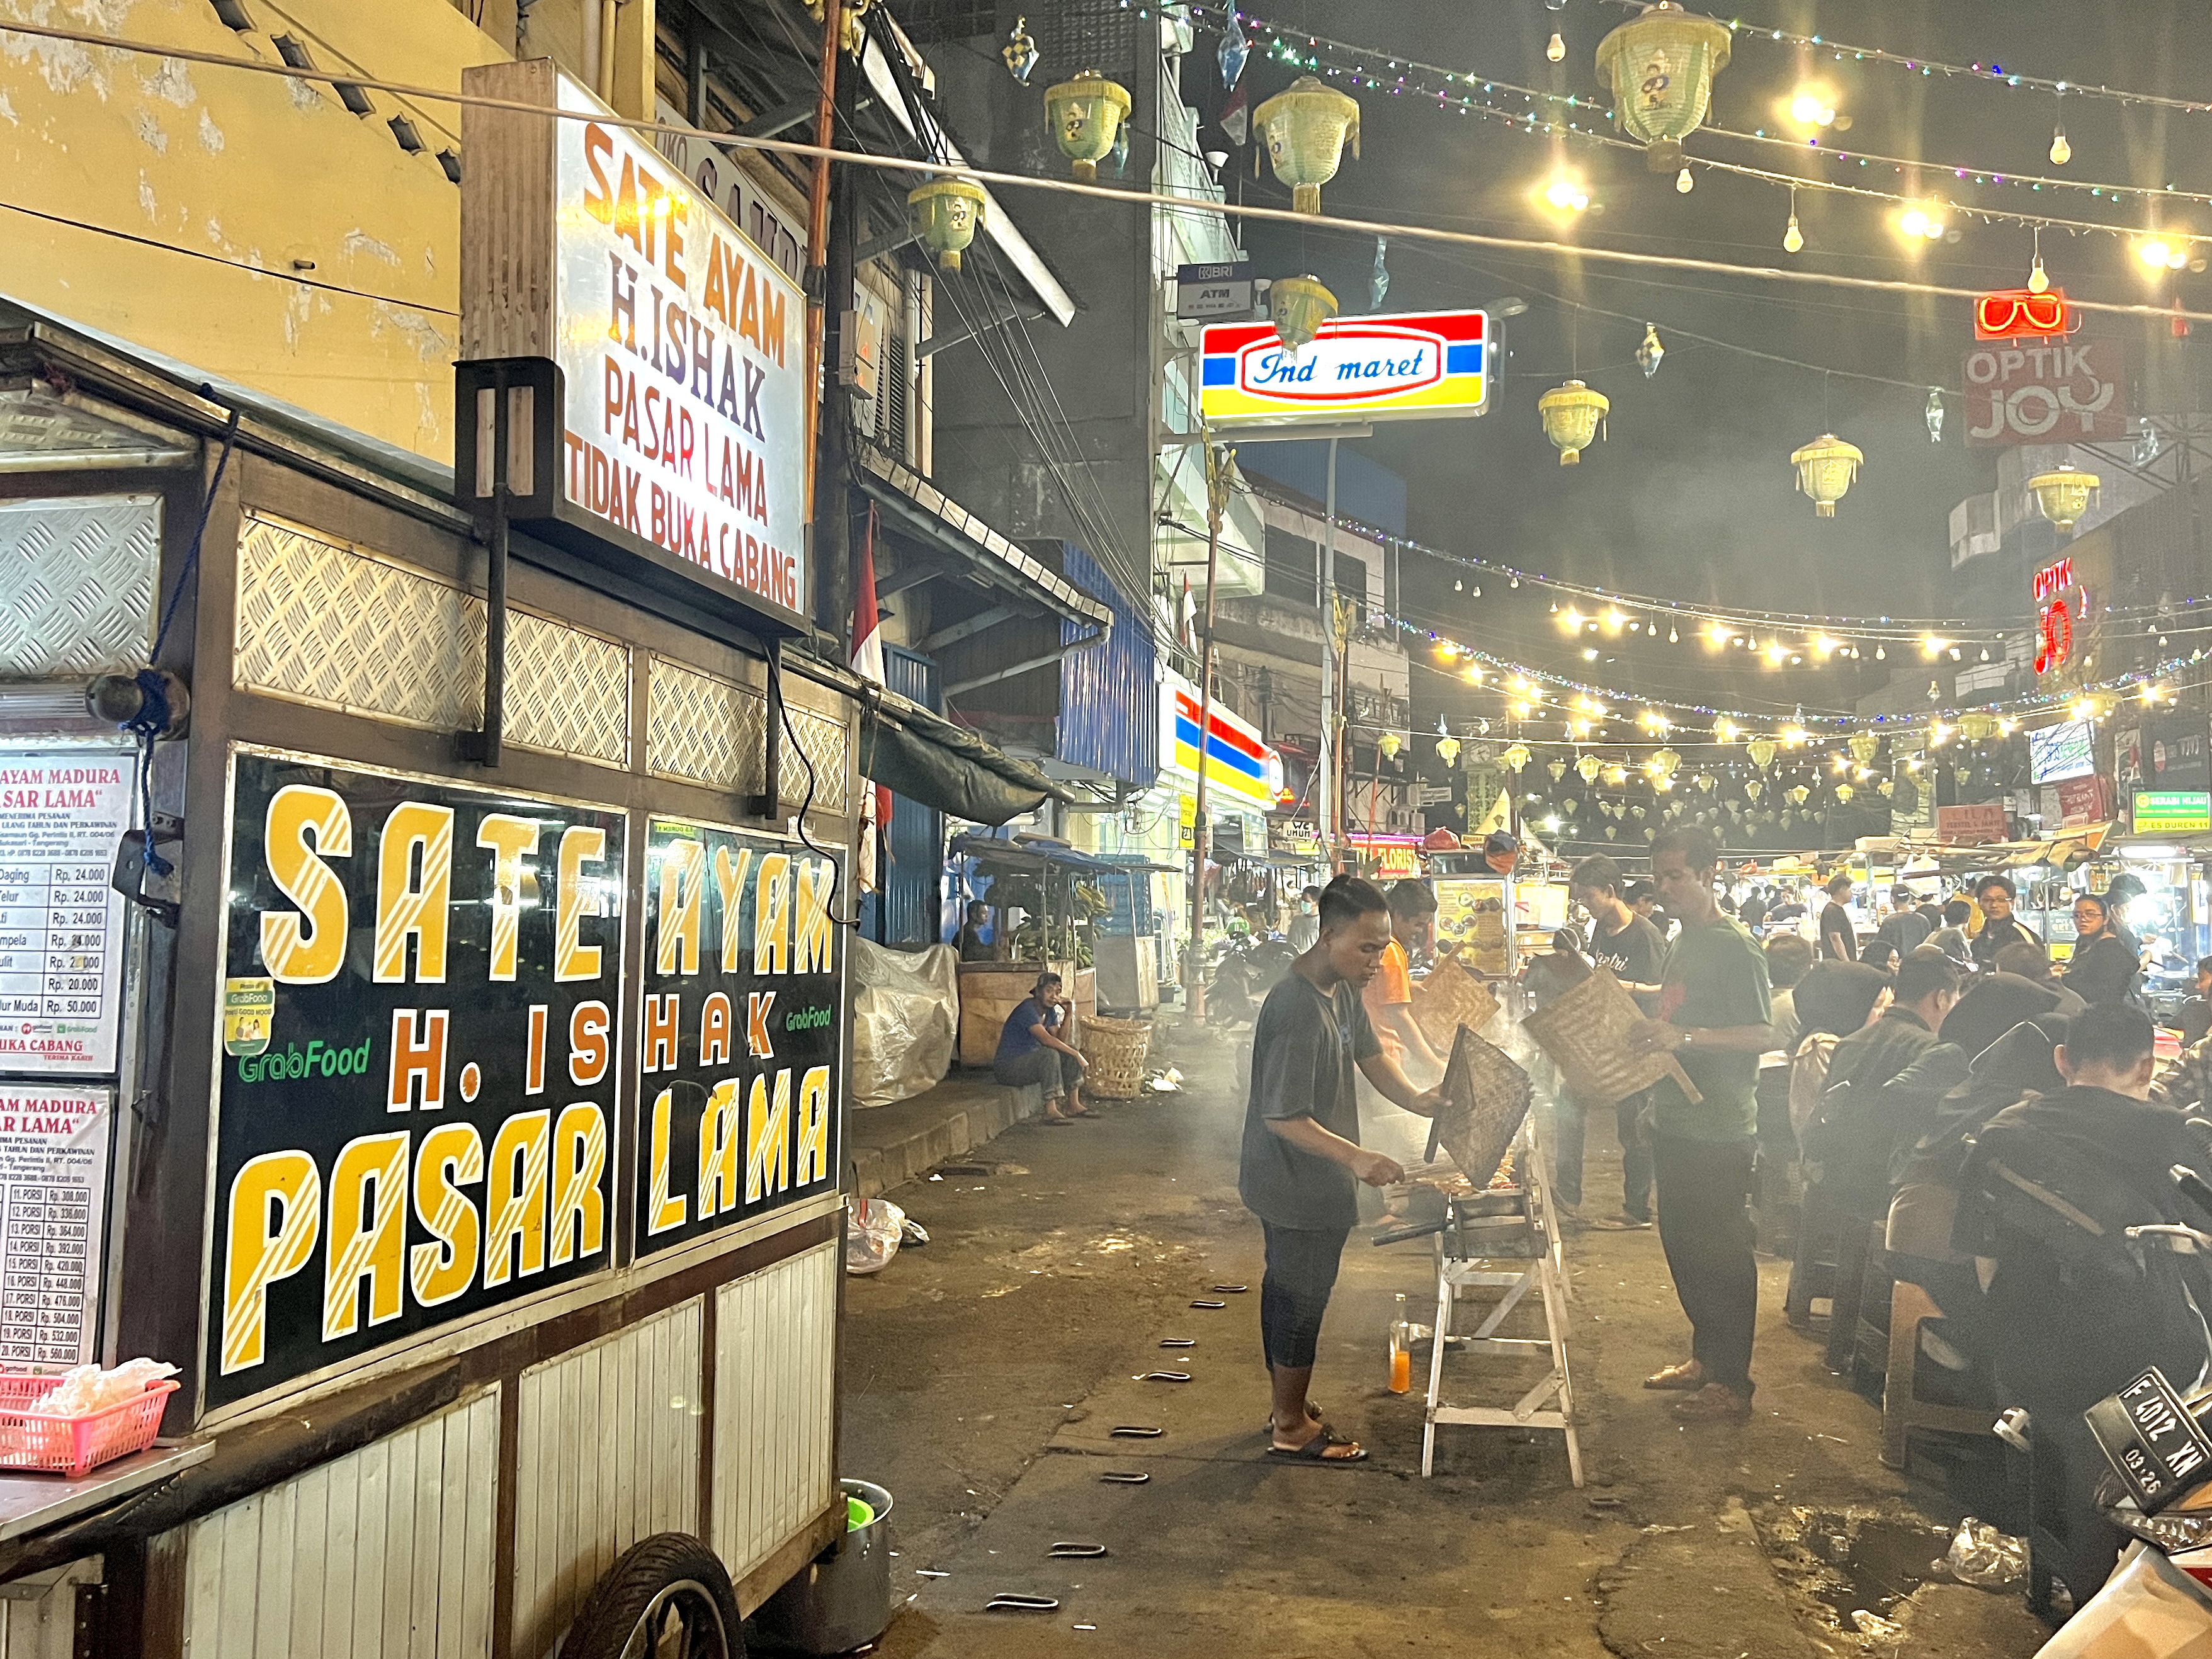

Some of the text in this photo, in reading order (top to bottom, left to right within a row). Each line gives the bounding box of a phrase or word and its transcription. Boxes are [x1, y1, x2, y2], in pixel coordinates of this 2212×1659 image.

[582, 120, 785, 369] SATE AYAM
[1212, 266, 1232, 277] BRI
[1200, 289, 1230, 299] ATM
[1966, 344, 2096, 384] OPTIK
[1970, 382, 2114, 439] JOY
[604, 354, 768, 527] PASAR LAMA
[564, 428, 797, 612] TIDAK BUKA CABANG
[2033, 557, 2072, 602] OPTIK
[0, 769, 120, 784] AYAM MADURA
[0, 790, 39, 808] SAR
[2150, 796, 2207, 805] SERABI HIJAU
[1293, 821, 1310, 830] WC
[1286, 830, 1310, 838] UMUM
[0, 868, 30, 883] Daging
[76, 869, 105, 881] 24.000
[259, 783, 835, 984] SATE AYAM
[54, 890, 69, 905] Rp.
[74, 890, 103, 902] 24.000
[52, 912, 67, 927] Rp.
[72, 912, 102, 924] 24.000
[51, 934, 67, 949] Rp.
[72, 934, 101, 946] 24.000
[50, 956, 65, 971] Rp.
[48, 978, 98, 993] Rp. 20.000
[231, 993, 268, 1004] GrabFood
[14, 1000, 38, 1012] Muda
[47, 1000, 62, 1015] Rp.
[67, 1000, 96, 1012] 50.000
[786, 1004, 831, 1031] GrabFood
[30, 1039, 82, 1051] CABANG
[239, 1037, 371, 1083] GrabFood
[387, 1007, 481, 1114] H.
[25, 1099, 96, 1114] MADURA
[47, 1147, 95, 1156] PERKAWINAN
[23, 1189, 42, 1201] PORSI
[49, 1190, 59, 1203] Rp.
[23, 1206, 42, 1218] PORSI
[48, 1208, 58, 1221] Rp.
[221, 1064, 831, 1376] PASAR LAMA
[21, 1223, 41, 1235] PORSI
[47, 1225, 57, 1238] Rp.
[20, 1240, 40, 1252] PORSI
[45, 1242, 56, 1255] Rp.
[18, 1259, 38, 1271] PORSI
[45, 1260, 55, 1274] Rp.
[17, 1276, 37, 1288] PORSI
[43, 1277, 53, 1291] Rp.
[16, 1293, 35, 1305] PORSI
[42, 1294, 52, 1308] Rp.
[14, 1310, 35, 1322] PORSI
[40, 1311, 50, 1326] Rp.
[13, 1328, 32, 1340] PORSI
[39, 1329, 48, 1343] Rp.
[11, 1345, 31, 1357] PORSI
[38, 1347, 47, 1361] Rp.
[2123, 1380, 2203, 1478] F 4012 XN
